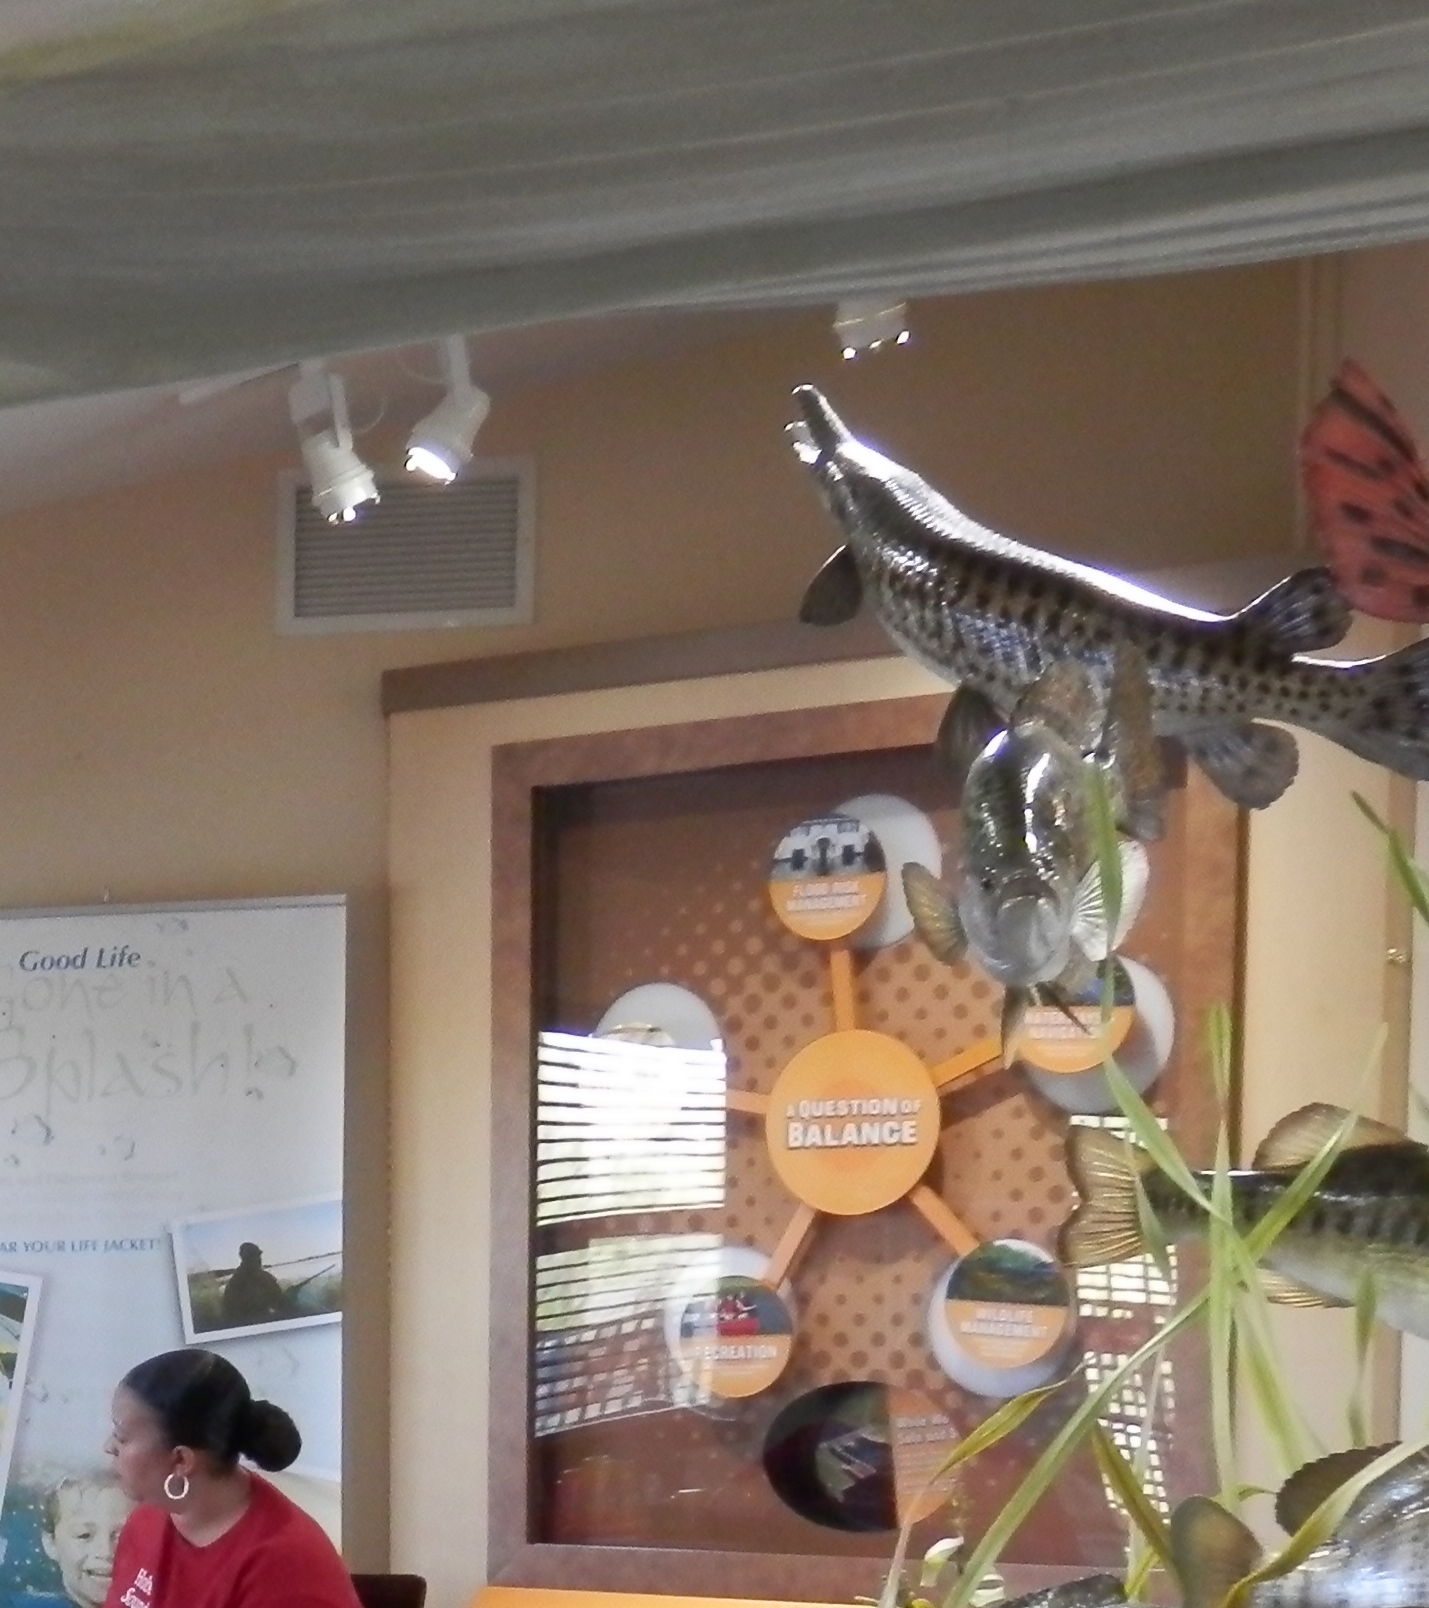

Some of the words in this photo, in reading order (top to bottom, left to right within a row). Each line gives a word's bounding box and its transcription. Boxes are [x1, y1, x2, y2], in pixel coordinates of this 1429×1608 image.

[19, 946, 88, 973] Good
[97, 944, 142, 969] Life
[799, 1099, 898, 1119] QUESTION
[900, 1098, 922, 1115] OF
[787, 1119, 918, 1149] BALANCE
[22, 1239, 66, 1255] YOUR
[71, 1239, 99, 1254] LIFE
